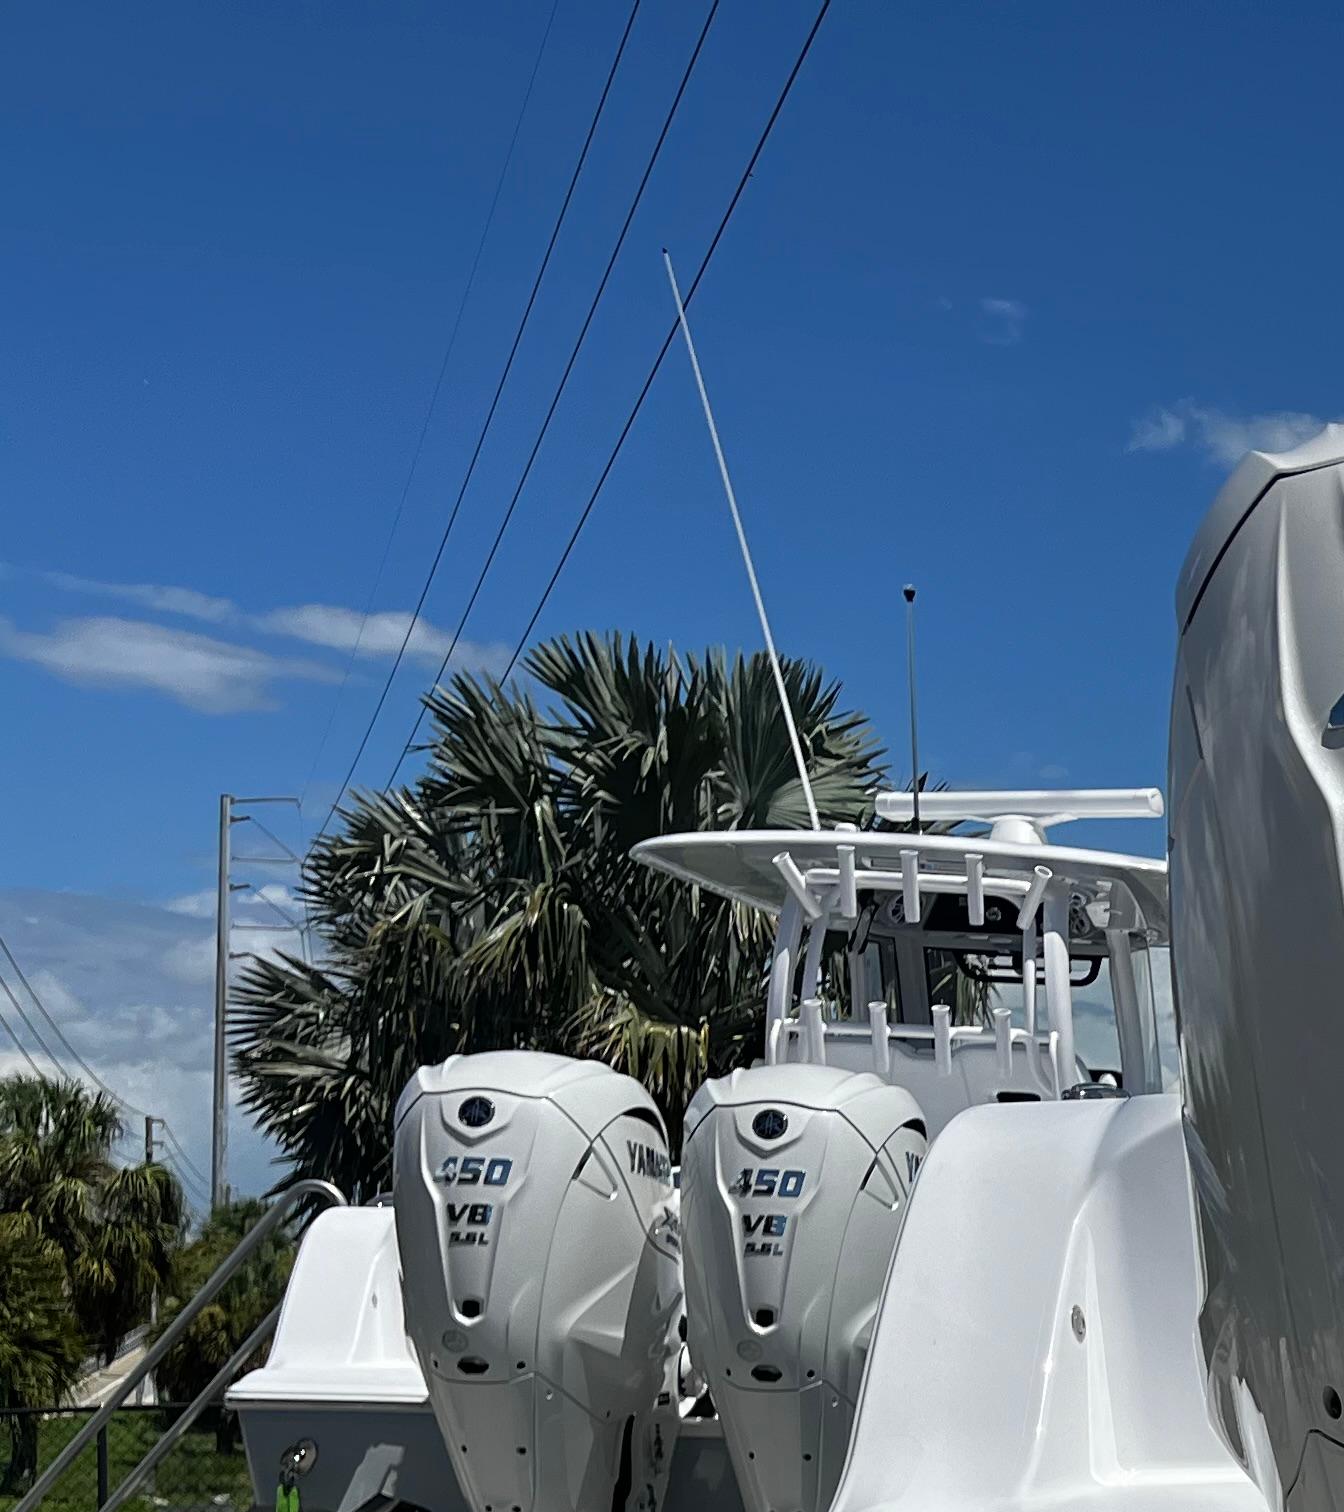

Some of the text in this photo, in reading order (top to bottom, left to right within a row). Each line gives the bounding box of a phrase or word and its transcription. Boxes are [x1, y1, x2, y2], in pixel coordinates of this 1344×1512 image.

[434, 1156, 513, 1186] 450
[729, 1168, 806, 1197] 450
[447, 1203, 493, 1227] V8
[742, 1214, 788, 1237] V8
